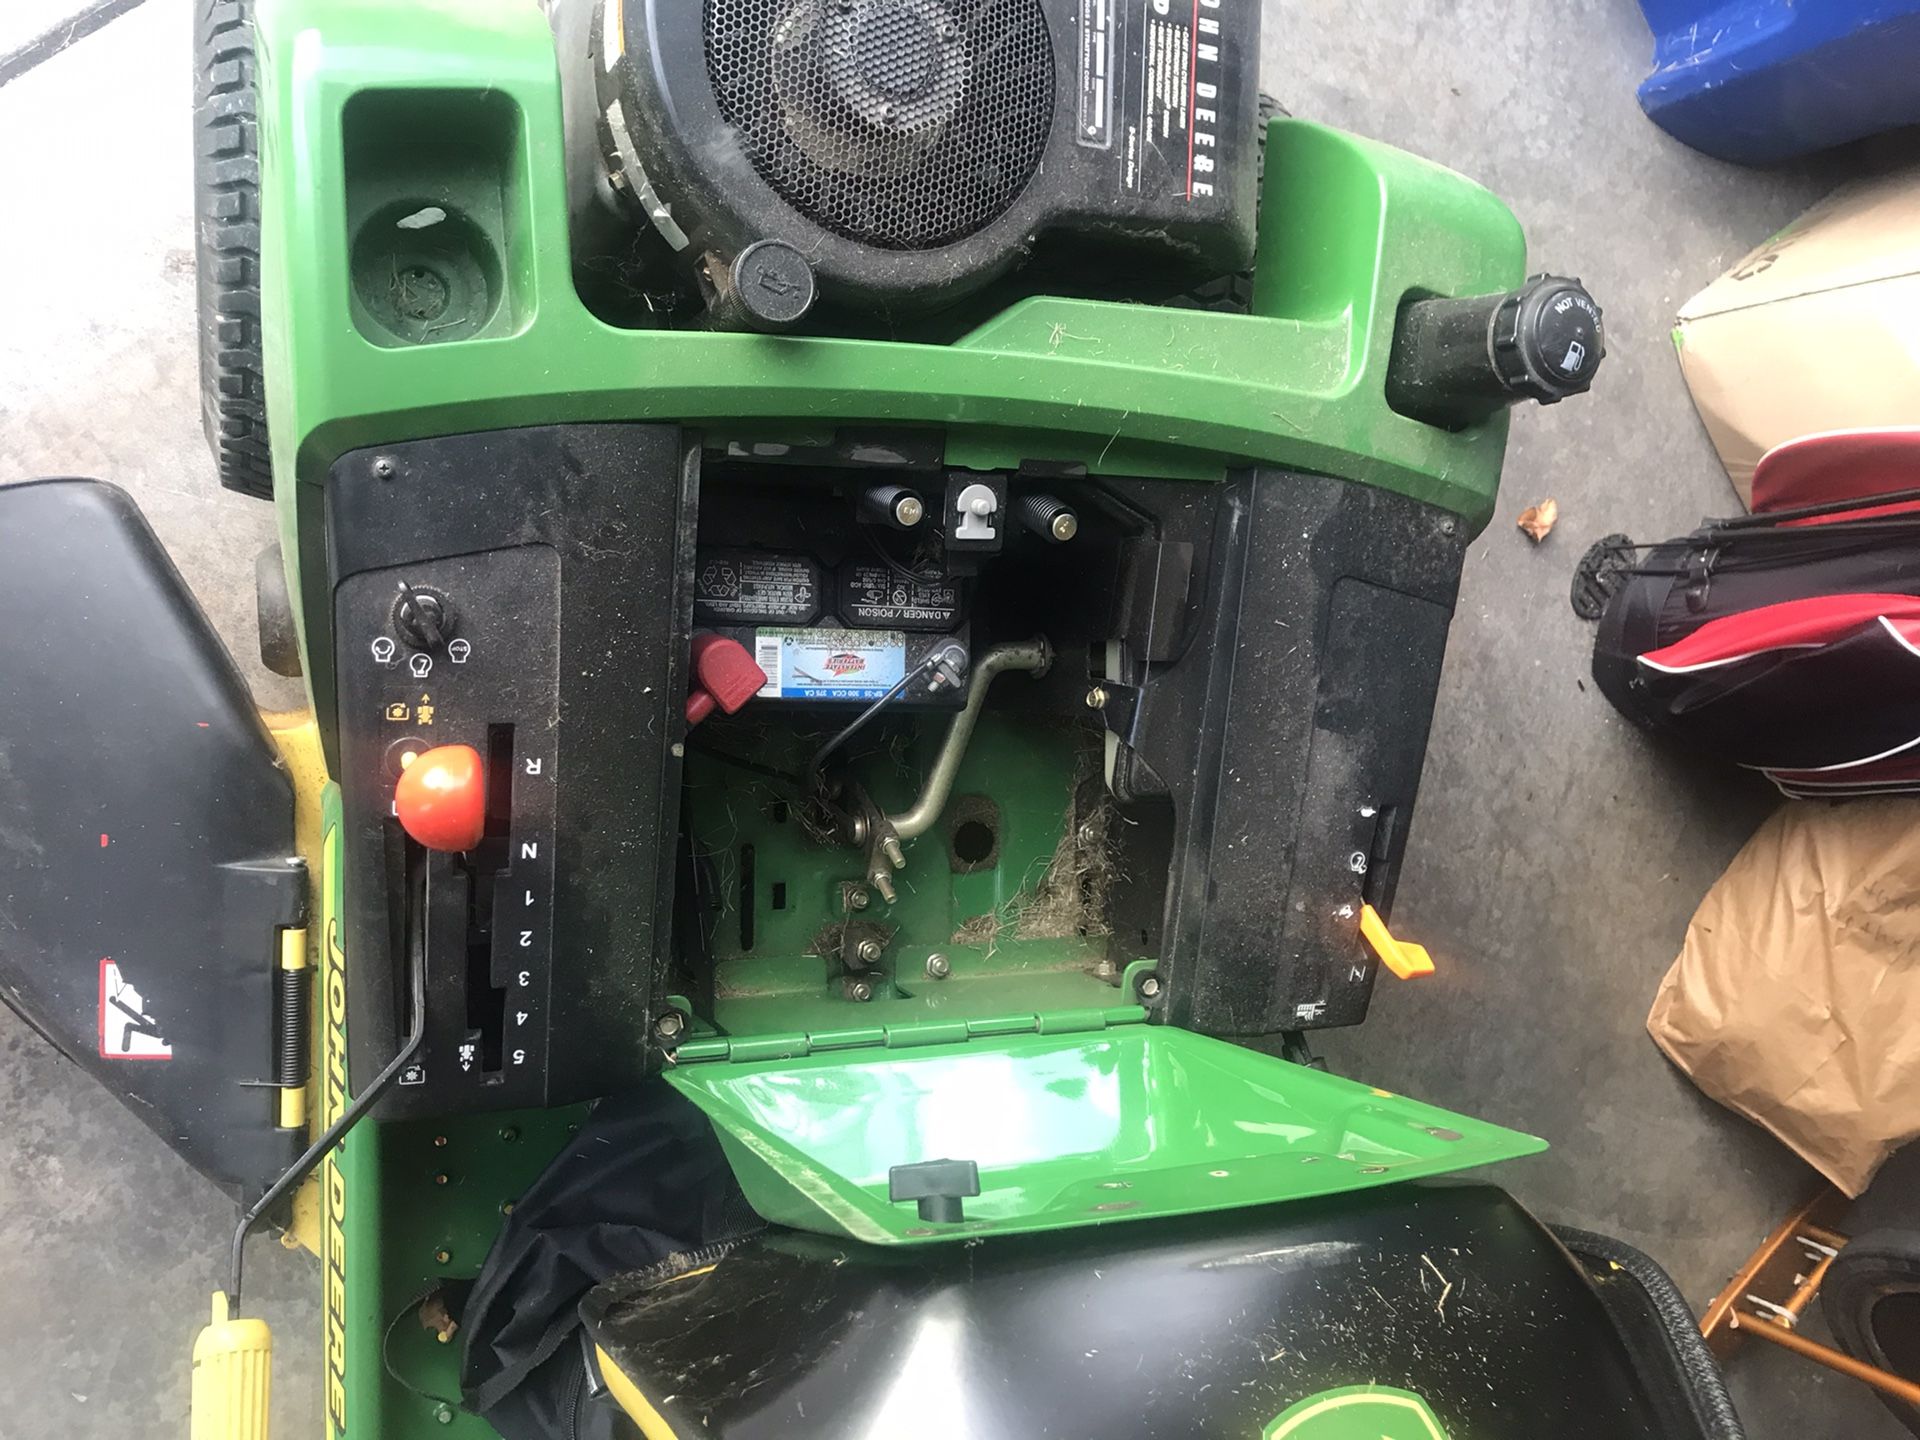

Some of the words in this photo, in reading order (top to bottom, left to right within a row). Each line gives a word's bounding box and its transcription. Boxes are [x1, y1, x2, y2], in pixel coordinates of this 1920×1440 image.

[1554, 297, 1573, 314] NOT
[1574, 297, 1600, 333] VENTED
[858, 608, 894, 618] POISON
[903, 610, 941, 620] DANGER
[526, 758, 541, 774] R
[521, 843, 537, 859] N
[525, 890, 534, 906] 1
[519, 931, 533, 947] 2
[518, 971, 530, 987] 3
[516, 1011, 528, 1026] 4
[512, 1050, 525, 1065] 5
[328, 1159, 346, 1437] DEERE
